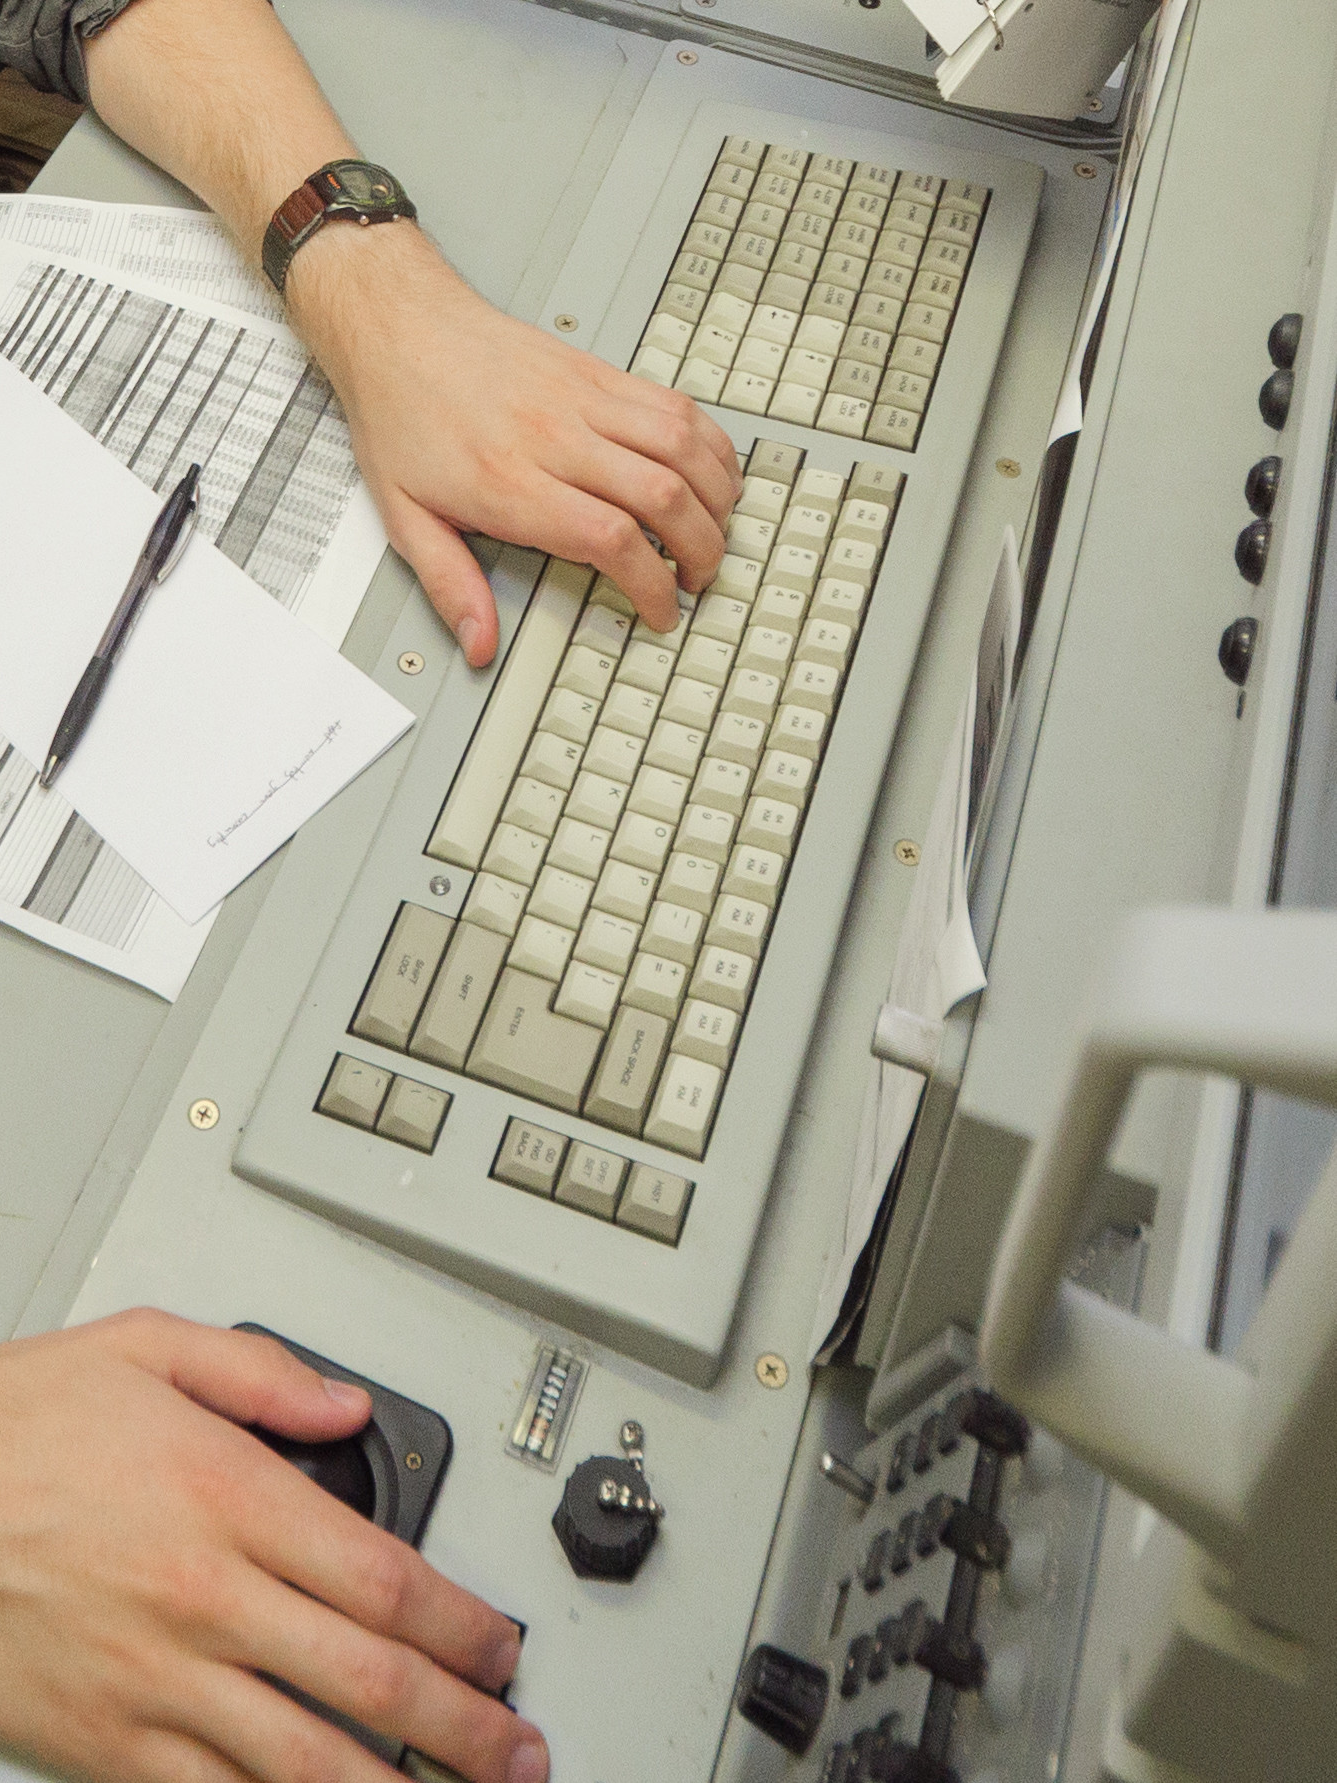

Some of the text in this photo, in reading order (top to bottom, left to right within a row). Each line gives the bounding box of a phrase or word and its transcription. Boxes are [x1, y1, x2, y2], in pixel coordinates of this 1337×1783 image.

[398, 955, 411, 977] LOCK
[411, 959, 424, 985] SHIFT
[460, 974, 473, 1001] SHIFT
[511, 1007, 524, 1036] ENTER
[621, 1030, 644, 1086] BACK SPACE
